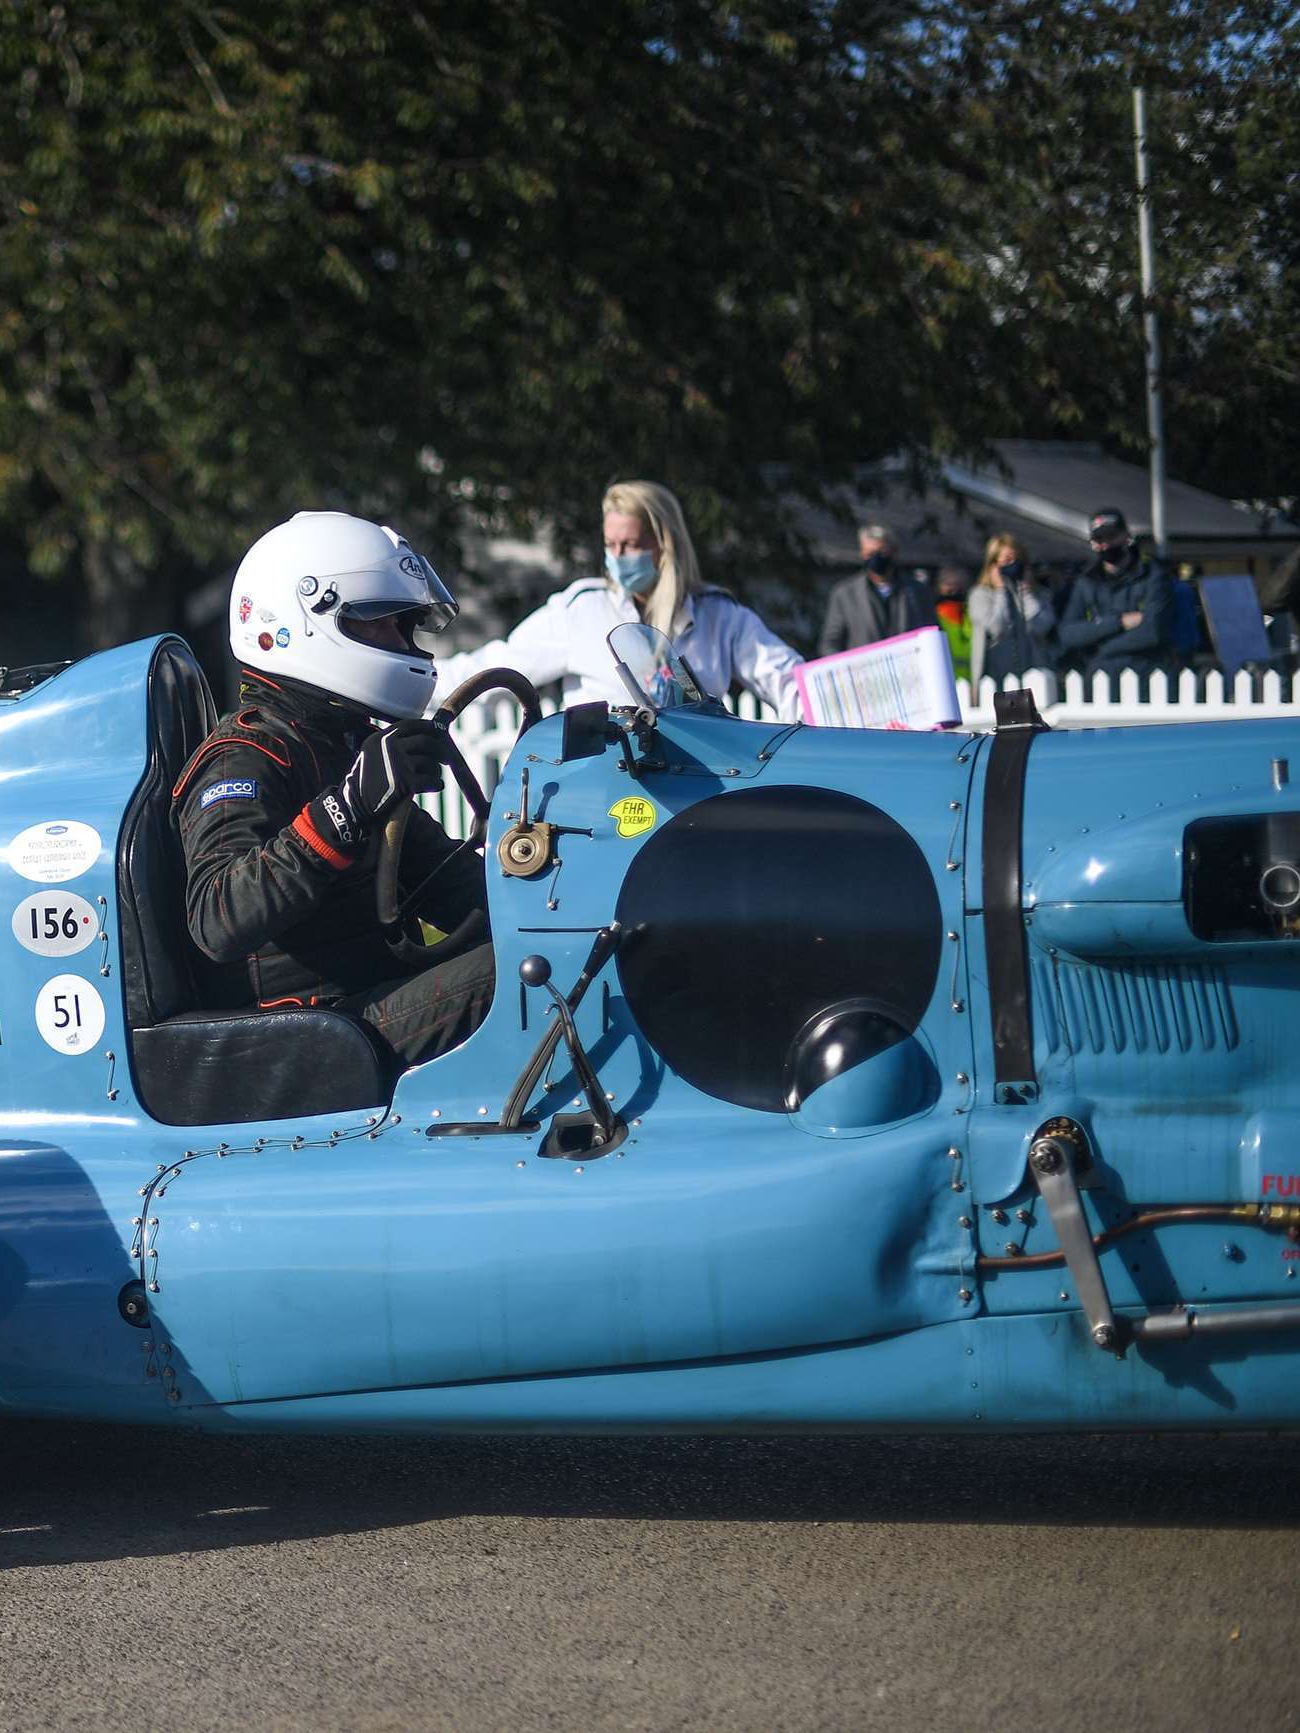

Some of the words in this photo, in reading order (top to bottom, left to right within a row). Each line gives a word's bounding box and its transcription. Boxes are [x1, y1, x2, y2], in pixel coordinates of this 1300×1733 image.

[202, 782, 252, 806] sparco
[322, 795, 352, 842] sparc
[622, 802, 645, 815] FHR
[623, 815, 652, 825] EXEMPT
[31, 907, 79, 939] 156
[54, 994, 81, 1028] 51
